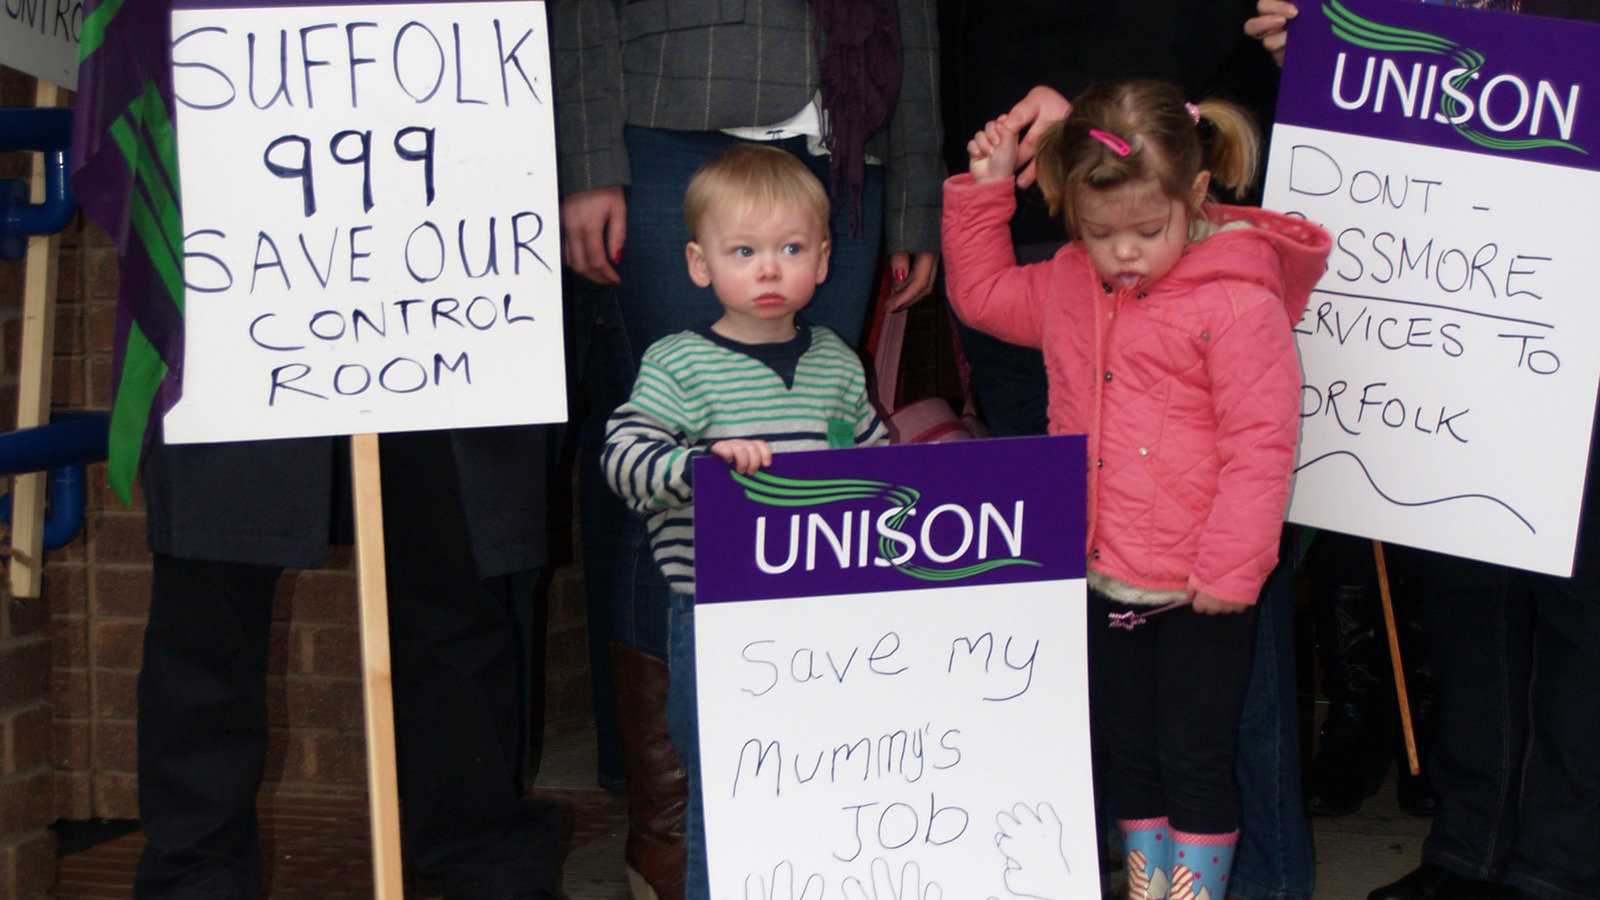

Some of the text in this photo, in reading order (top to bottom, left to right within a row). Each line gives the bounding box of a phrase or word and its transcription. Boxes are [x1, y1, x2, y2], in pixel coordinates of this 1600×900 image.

[172, 18, 542, 110] SUFFOLK
[1331, 53, 1580, 140] UNISON
[263, 126, 436, 218] 999
[1289, 145, 1442, 213] DONT
[184, 211, 553, 294] SAVE OUR
[1285, 211, 1552, 299] SSMORE
[249, 293, 535, 351] CONTROL
[1292, 302, 1560, 375] ERVICES TO
[268, 351, 471, 406] ROOM
[1299, 380, 1469, 443] ORFOLK
[754, 500, 1025, 575] UNISON
[741, 631, 1040, 701] Save my
